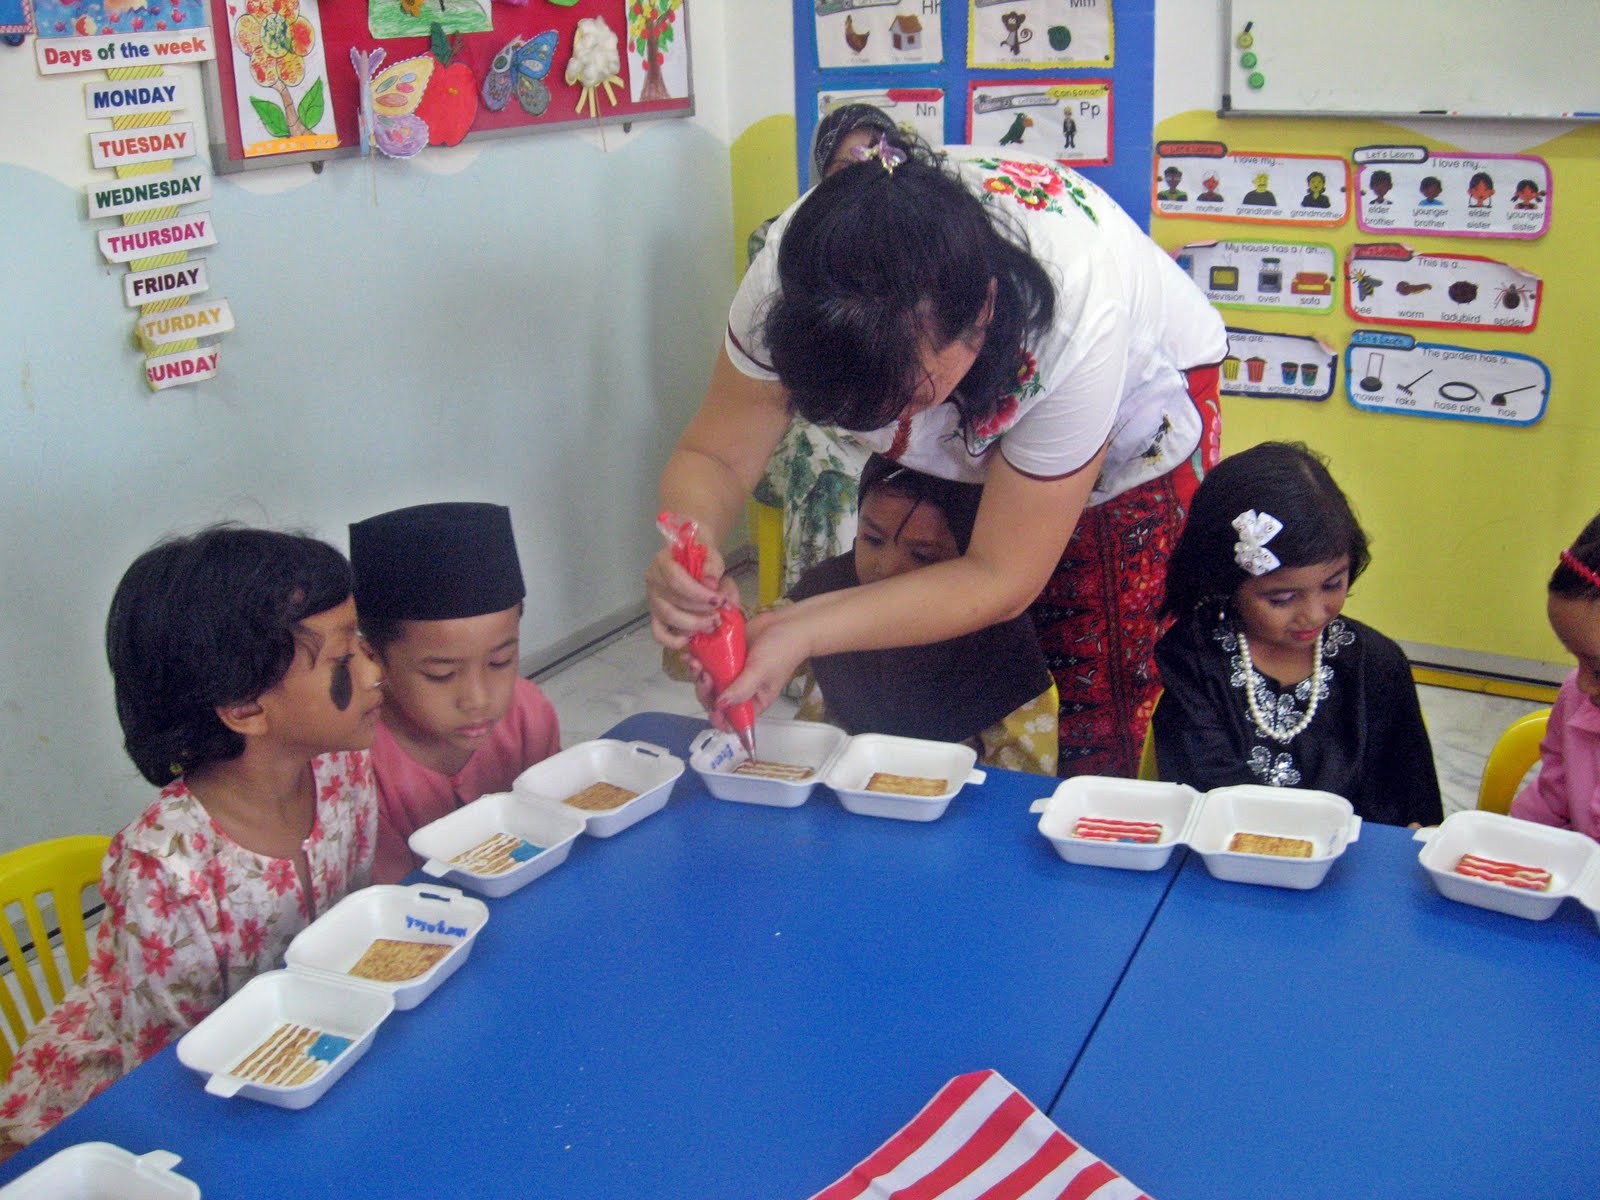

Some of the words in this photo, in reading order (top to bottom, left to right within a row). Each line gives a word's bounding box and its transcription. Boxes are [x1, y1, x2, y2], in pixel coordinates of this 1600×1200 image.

[44, 47, 93, 67] Days
[98, 43, 115, 60] of
[121, 42, 150, 59] the
[154, 37, 207, 56] week
[94, 85, 176, 108] MONDAY
[916, 103, 937, 116] Nn
[1080, 101, 1101, 119] Pp
[99, 132, 187, 158] TUESDAY
[1390, 151, 1415, 160] Learn
[1239, 157, 1258, 165] love
[1438, 159, 1460, 168] love
[95, 175, 202, 208] WEDNESDAY
[1196, 205, 1224, 213] mother
[1236, 206, 1283, 216] grandfather
[1368, 206, 1390, 214] elder
[1412, 208, 1449, 217] younger
[1468, 209, 1492, 218] elder
[1290, 209, 1343, 220] grandmother
[1506, 211, 1544, 221] younger
[1365, 217, 1395, 226] brother
[1414, 219, 1445, 228] brother
[1467, 221, 1491, 229] sister
[1512, 222, 1537, 232] sister
[107, 221, 205, 253] THURSDAY
[1225, 243, 1239, 253] My
[1241, 244, 1269, 252] house
[1272, 244, 1289, 253] has
[1417, 258, 1438, 268] This
[1439, 259, 1449, 268] is
[133, 268, 199, 296] FRIDAY
[1300, 297, 1321, 305] sofa
[1354, 306, 1372, 315] bee
[1398, 310, 1425, 318] worm
[143, 307, 221, 337] TURDAY
[1441, 312, 1481, 323] ladybird
[1494, 317, 1525, 327] spider
[1421, 348, 1440, 358] The
[1442, 351, 1477, 361] garden
[1479, 353, 1498, 364] has
[1353, 393, 1385, 402] mower
[1395, 397, 1416, 407] rake
[1433, 400, 1457, 411] hose
[1460, 403, 1481, 414] pipe
[1498, 407, 1517, 418] hoe
